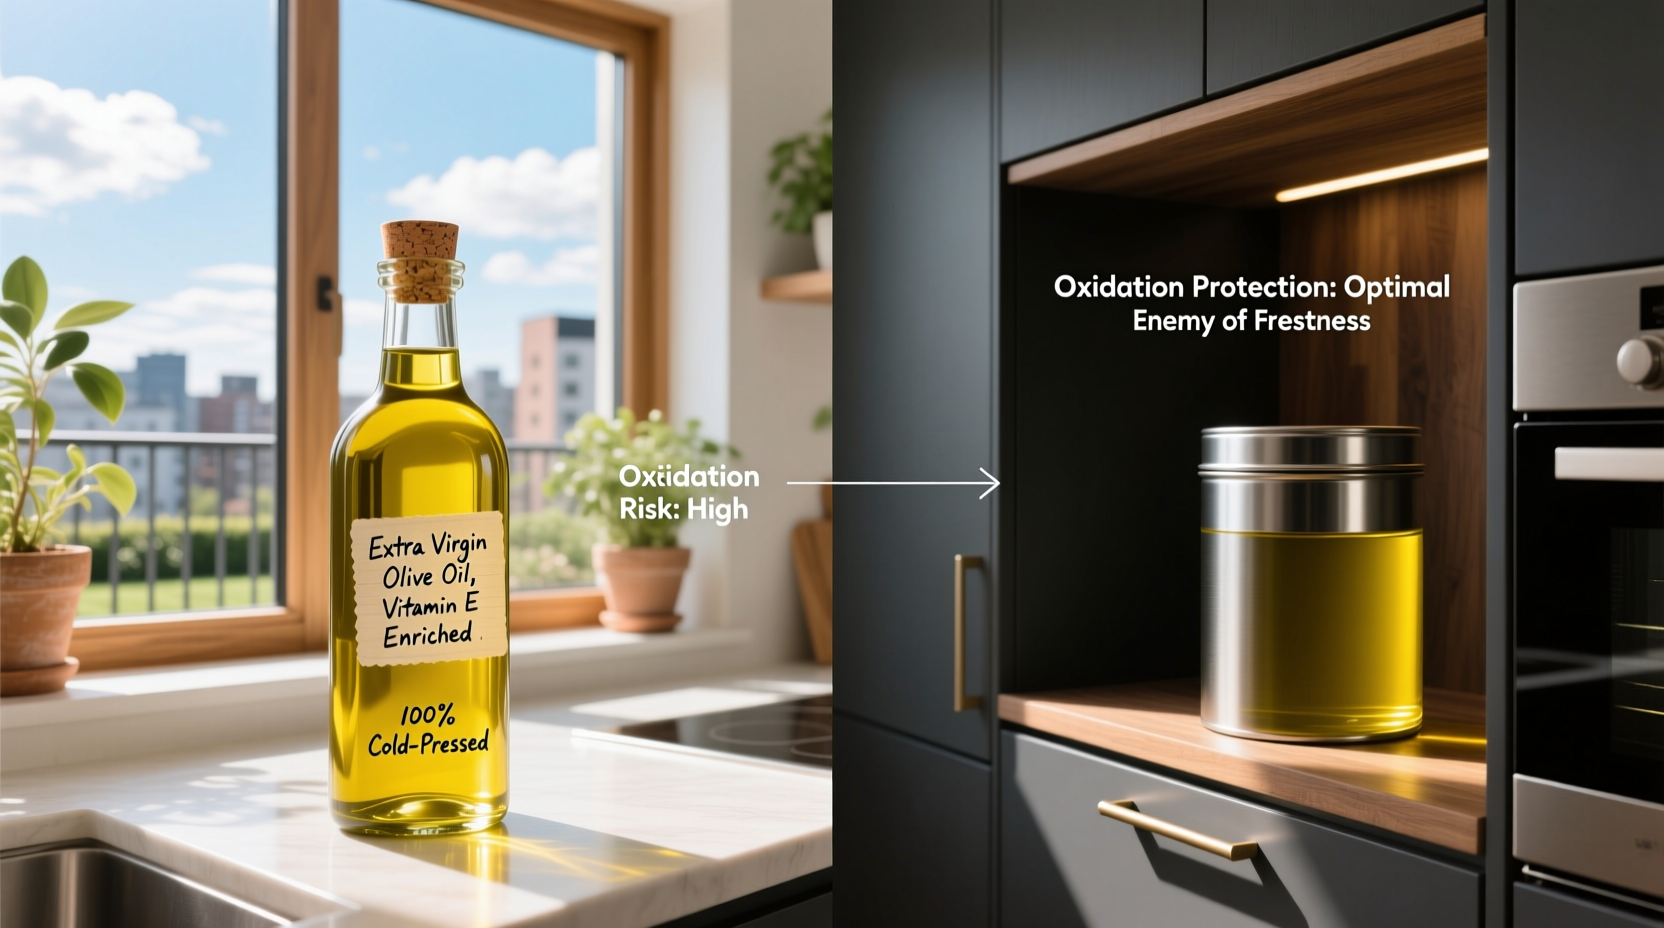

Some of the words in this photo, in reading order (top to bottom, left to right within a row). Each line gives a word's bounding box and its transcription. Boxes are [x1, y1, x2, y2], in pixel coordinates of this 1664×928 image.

[369, 535, 425, 560] Extra
[431, 531, 487, 563] Virgin
[383, 566, 433, 589] Olive
[442, 563, 476, 587] Oil,
[382, 596, 457, 619] Vitamin
[465, 590, 480, 612] E
[383, 620, 472, 648] Enriched
[400, 702, 456, 727] 100%
[368, 728, 489, 757] Cold-Pressed
